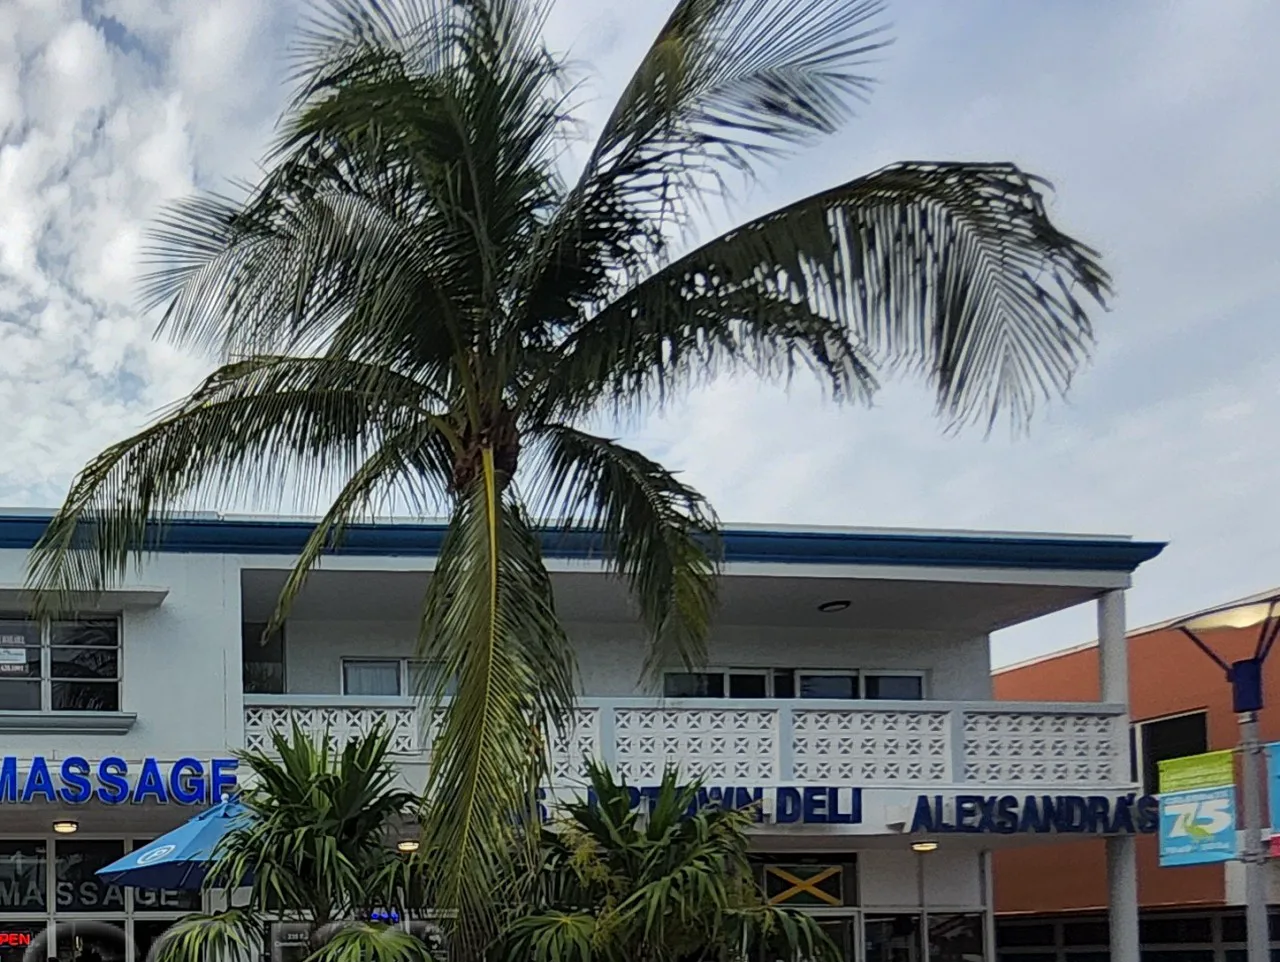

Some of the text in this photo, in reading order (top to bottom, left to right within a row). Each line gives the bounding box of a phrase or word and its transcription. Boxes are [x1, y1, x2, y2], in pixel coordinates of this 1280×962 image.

[776, 787, 862, 824] DELI
[910, 793, 1159, 835] ALEXSANDRA'S
[1164, 799, 1232, 837] 75
